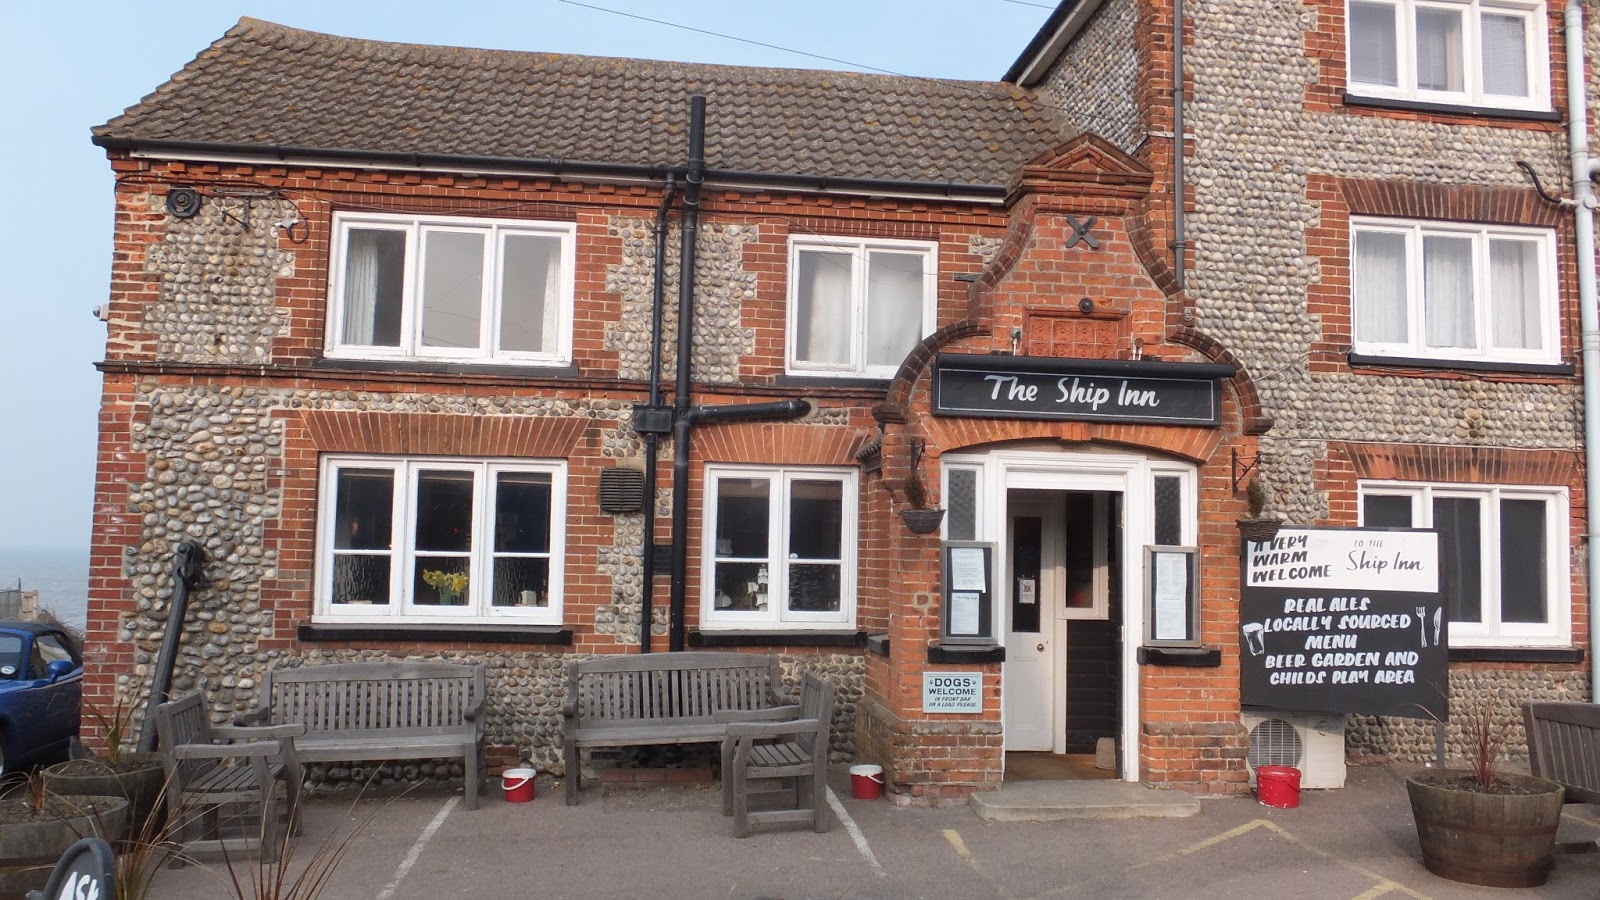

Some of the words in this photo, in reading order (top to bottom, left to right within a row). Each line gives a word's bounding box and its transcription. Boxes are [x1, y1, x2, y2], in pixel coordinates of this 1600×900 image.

[984, 375, 1037, 401] The
[1056, 377, 1109, 410] Ship
[1118, 380, 1160, 407] Inn
[1270, 535, 1308, 551] VERY
[1353, 540, 1364, 548] TO
[1369, 540, 1385, 548] THE
[1253, 551, 1308, 567] WARM
[1346, 550, 1388, 574] Ship
[1393, 551, 1424, 571] Inn
[1252, 564, 1332, 583] WELCOME
[1284, 598, 1327, 613] REAL
[1329, 597, 1371, 611] ALES
[1265, 615, 1332, 632] LOCALLY
[1338, 614, 1411, 630] SOURCED
[1304, 634, 1358, 649] MENU
[1265, 653, 1307, 668] BEER
[1311, 652, 1380, 667] GARDEN
[1385, 651, 1419, 666] AND
[934, 678, 971, 687] DOGS
[1269, 671, 1327, 685] CHILDS
[1332, 670, 1368, 684] PLAY
[1374, 669, 1415, 683] AREA
